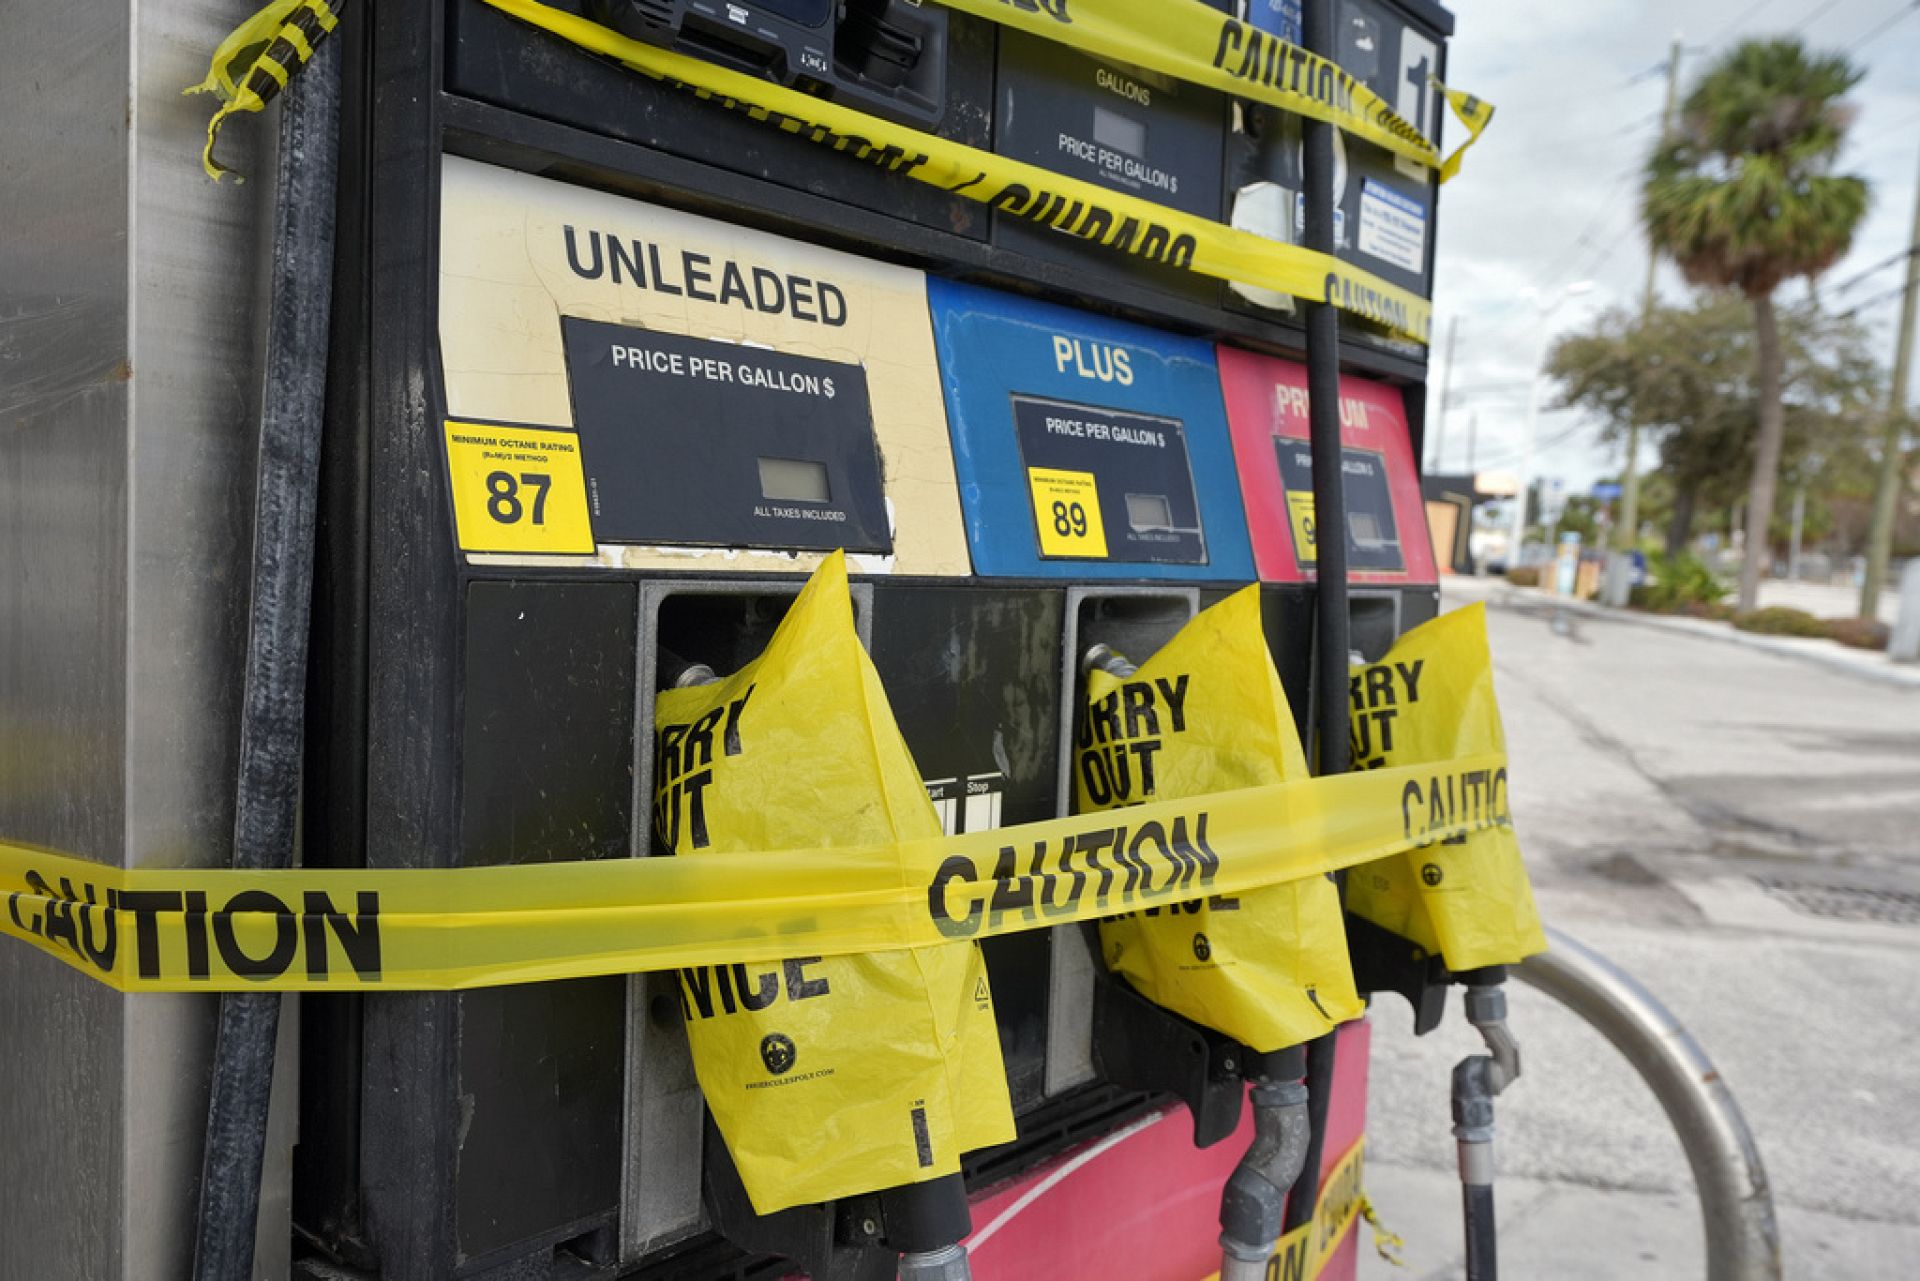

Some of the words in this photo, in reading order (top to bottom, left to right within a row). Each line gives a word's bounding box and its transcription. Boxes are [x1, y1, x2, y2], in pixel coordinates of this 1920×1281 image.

[1096, 68, 1151, 106] GALLONS
[1406, 55, 1428, 141] 1
[1059, 132, 1096, 163] PRICE
[1098, 148, 1122, 172] PER
[1124, 159, 1169, 190] GALLON
[563, 224, 848, 328] UNLEADED
[611, 344, 685, 376] PRICE
[689, 356, 734, 383] PER
[738, 365, 820, 395] GALLON
[822, 376, 836, 399] $
[1052, 335, 1134, 386] PLUS
[1046, 417, 1085, 437] PRICE
[1085, 423, 1111, 441] PER
[1111, 426, 1156, 446] GALLON
[1276, 383, 1369, 430] PRUM
[452, 435, 497, 447] MINIMUM
[500, 438, 538, 451] OCTANE
[539, 442, 574, 453] RATING
[486, 470, 552, 526] 87
[753, 506, 771, 517] ALL
[772, 507, 801, 519] TAXES
[801, 508, 846, 522] INCLUDED
[1052, 500, 1087, 537] 89
[1080, 674, 1189, 749] RRY
[1350, 659, 1424, 710] RRY
[1350, 708, 1398, 764] UT
[967, 781, 989, 795] Stop
[1082, 739, 1161, 806] OUT
[654, 768, 710, 855] UT
[1402, 766, 1512, 840] CAUTIO
[928, 811, 1219, 938] CAUTION
[8, 870, 382, 982] CAUTION
[676, 955, 830, 1021] VICE
